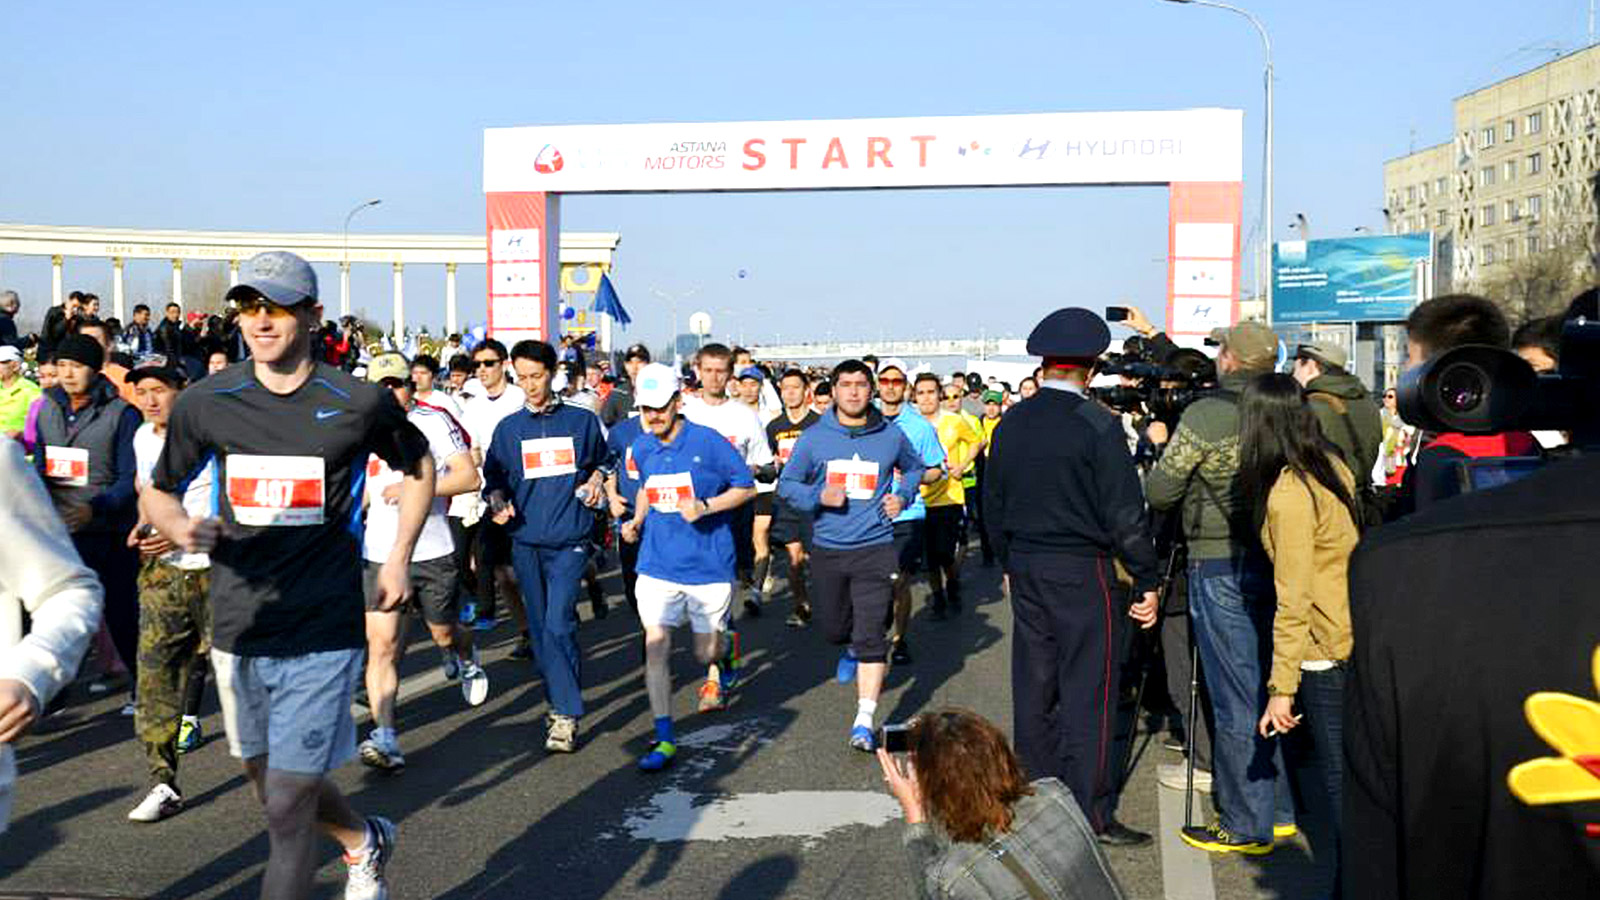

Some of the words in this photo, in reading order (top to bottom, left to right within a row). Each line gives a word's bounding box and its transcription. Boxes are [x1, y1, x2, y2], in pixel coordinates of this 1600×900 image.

[670, 141, 727, 152] ASTANA
[742, 135, 937, 171] START
[1066, 138, 1182, 156] HYUNDAI
[644, 155, 726, 169] MOTORS
[254, 479, 295, 507] 407
